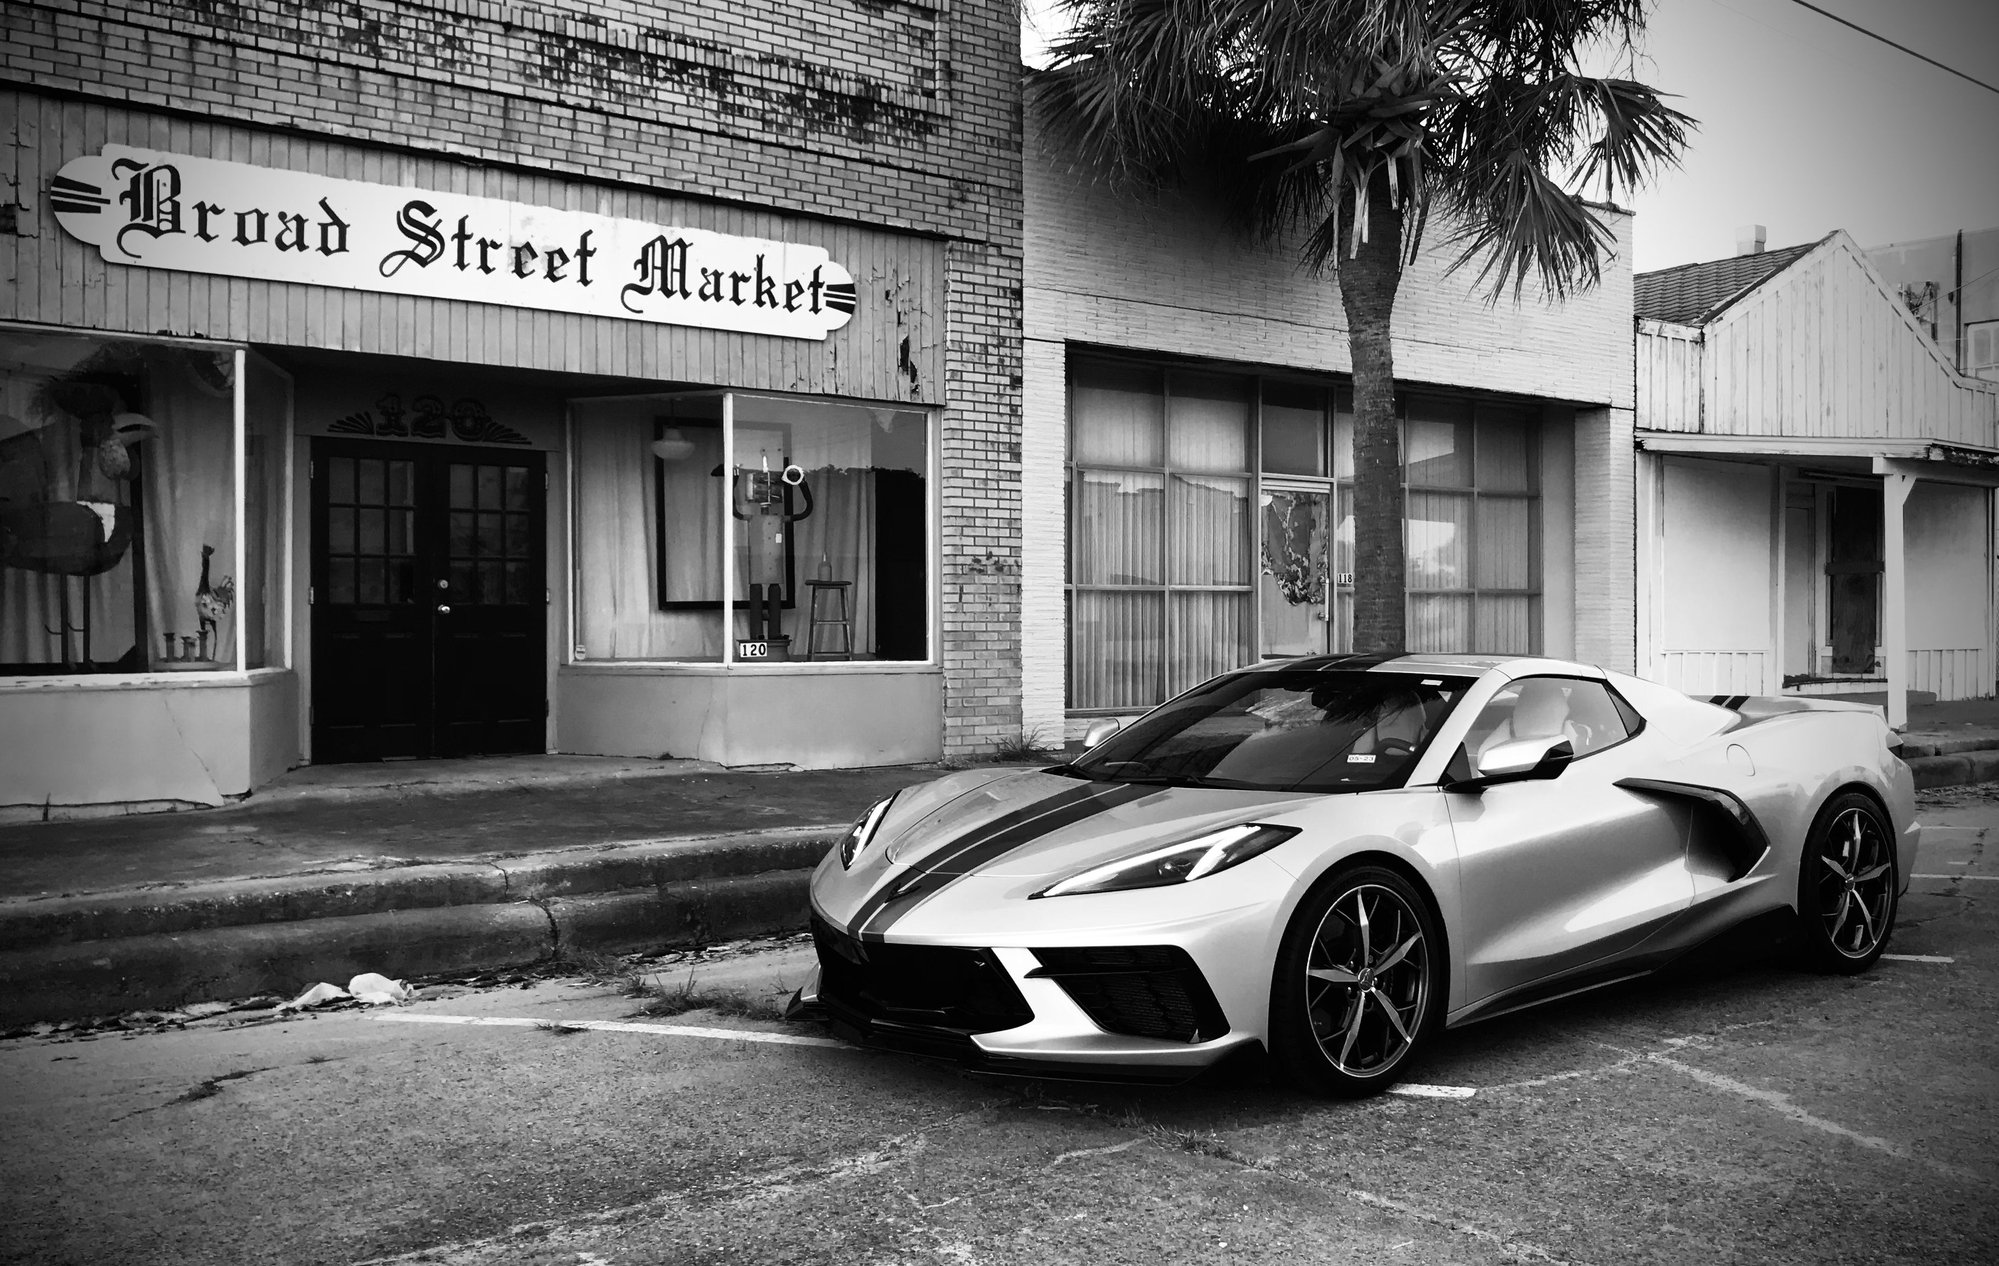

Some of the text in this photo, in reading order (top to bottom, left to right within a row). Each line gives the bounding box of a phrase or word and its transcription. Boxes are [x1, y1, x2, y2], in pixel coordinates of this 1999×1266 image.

[112, 158, 825, 315] Broad Street Market
[375, 393, 485, 443] 120
[1339, 573, 1353, 583] 118
[742, 643, 767, 657] 120
